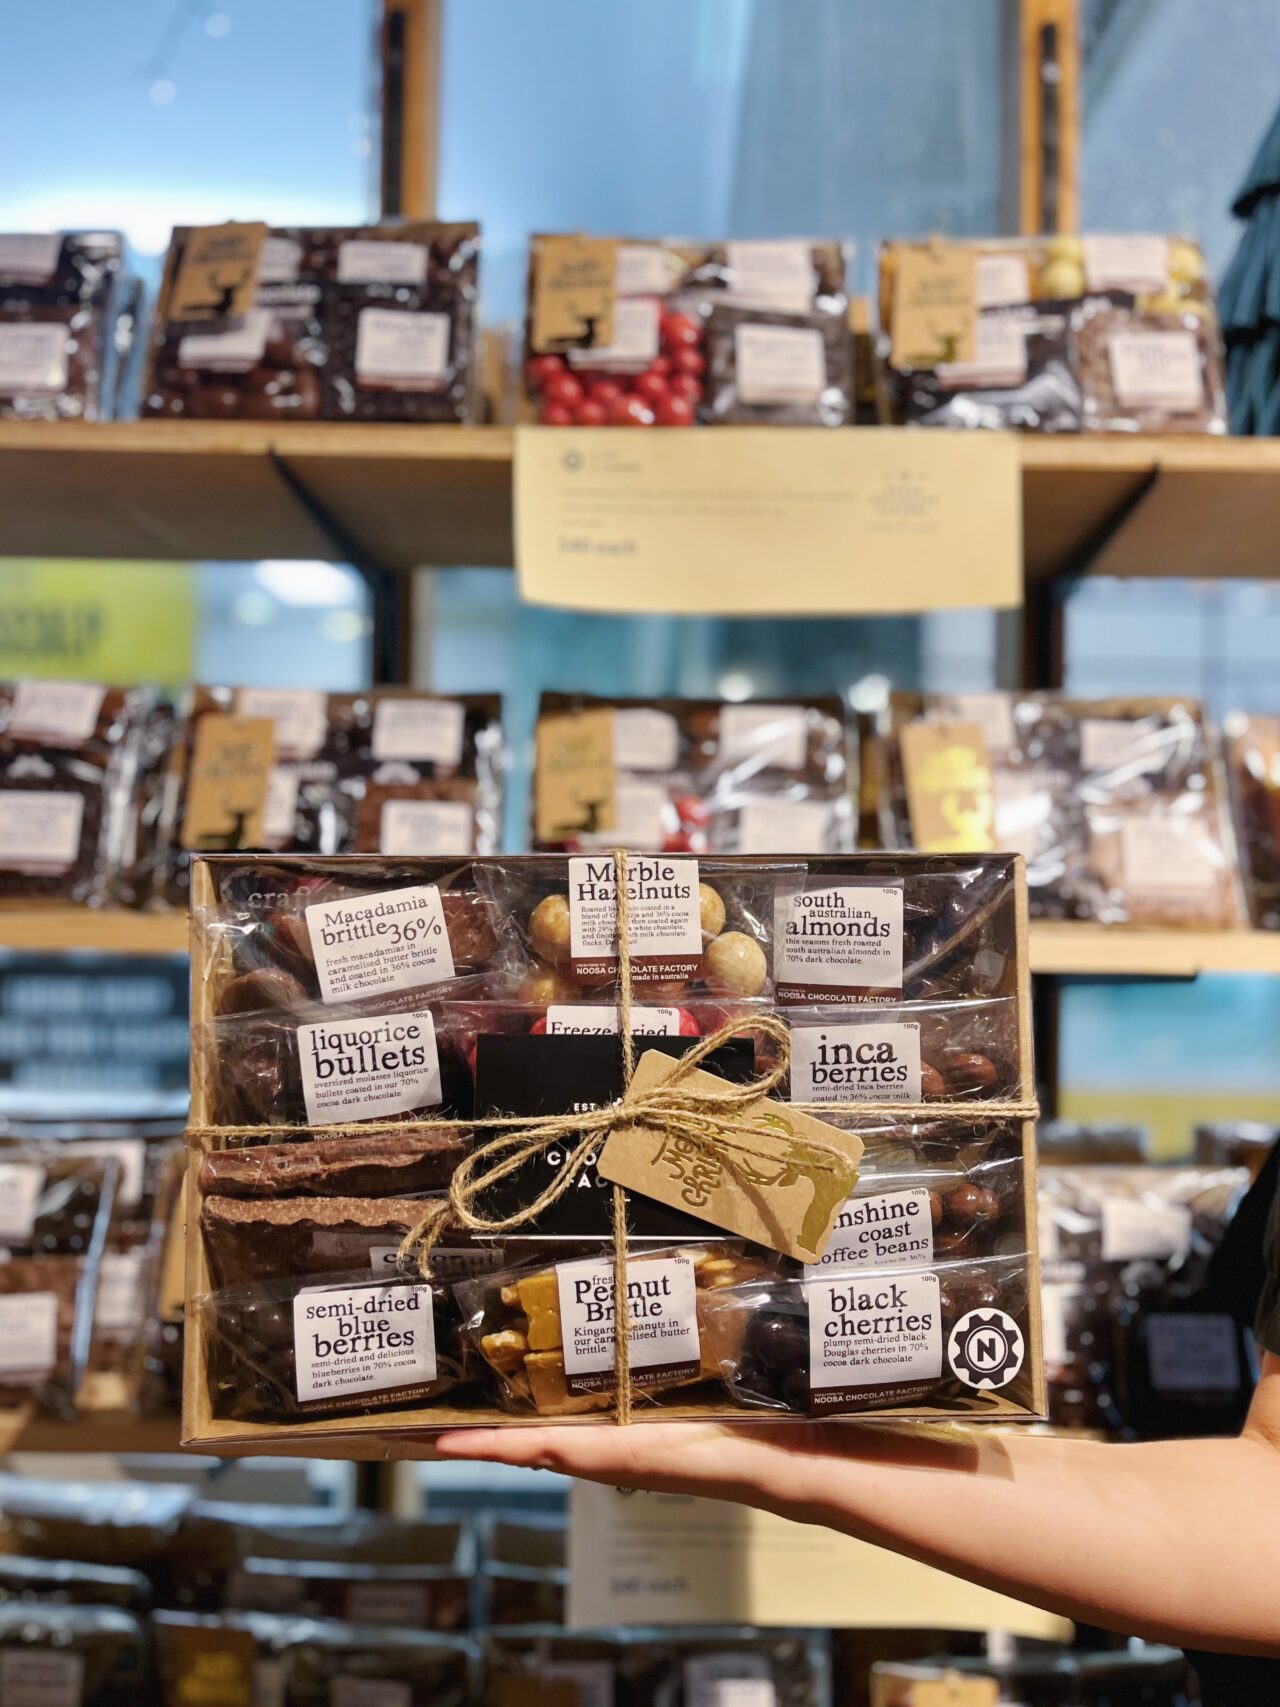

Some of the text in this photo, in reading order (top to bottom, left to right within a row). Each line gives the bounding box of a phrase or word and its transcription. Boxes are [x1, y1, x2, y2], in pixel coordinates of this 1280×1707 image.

[793, 892, 845, 908] south
[324, 896, 428, 927] Macadamia
[809, 908, 872, 919] australian
[320, 916, 442, 946] brittle 36%
[785, 916, 890, 937] almonds
[807, 947, 846, 955] australian
[848, 948, 881, 956] almonds
[853, 939, 882, 947] roasted
[326, 942, 416, 967] fresh macadamias in
[327, 946, 438, 976] caramelised butter brittle
[787, 955, 803, 963] 70%
[805, 956, 823, 964] dark
[329, 957, 436, 985] and coated in 36% cocoa
[576, 964, 698, 975] NOOSA CHOLATE FACTORY
[331, 974, 395, 994] milk chocolate
[778, 991, 897, 1004] NOOSA CHOCOLATE FACTORY
[310, 1021, 420, 1054] liquorice
[551, 1022, 668, 1036] Freeze-ried
[817, 1034, 898, 1066] inca
[311, 1044, 426, 1079] bullets
[314, 1066, 429, 1089] oversized molasses liquorice
[810, 1061, 908, 1083] berries
[315, 1089, 344, 1099] bullets
[345, 1085, 372, 1096] coated
[384, 1081, 398, 1090] our
[401, 1078, 419, 1088] 70%
[812, 1084, 855, 1092] semi-dried
[812, 1094, 838, 1102] coated
[849, 1093, 866, 1101] 36%
[316, 1099, 340, 1109] cocoa
[342, 1095, 361, 1106] dark
[574, 1103, 600, 1111] EST.
[833, 1199, 920, 1230] nshine
[858, 1221, 911, 1243] coast
[814, 1238, 929, 1265] offee beans
[592, 1275, 616, 1285] fres
[921, 1275, 937, 1283] 100g
[306, 1293, 420, 1320] semi-dried
[829, 1284, 908, 1313] black
[586, 1296, 663, 1322] Brtle
[337, 1315, 391, 1337] blue
[668, 1319, 679, 1328] in
[824, 1308, 932, 1337] cherries
[312, 1330, 414, 1358] berries
[574, 1327, 691, 1346] our caraelised butter
[823, 1332, 927, 1349] plump semi-dried black
[311, 1349, 414, 1368] semi-dried and delicious
[823, 1342, 929, 1358] Douglas cherries in 70%
[977, 1338, 996, 1362] N
[312, 1366, 360, 1378] blueberries
[373, 1361, 391, 1370] 70%
[394, 1359, 416, 1367] cocoa
[823, 1354, 913, 1367] cocoa dark chocolate
[656, 1367, 695, 1378] FACTORY
[312, 1379, 332, 1389] dark
[336, 1395, 387, 1408] CHOCOLATE
[391, 1387, 430, 1398] FACTORY
[814, 1395, 844, 1404] NOOSA
[845, 1390, 894, 1401] CHOCOLATE
